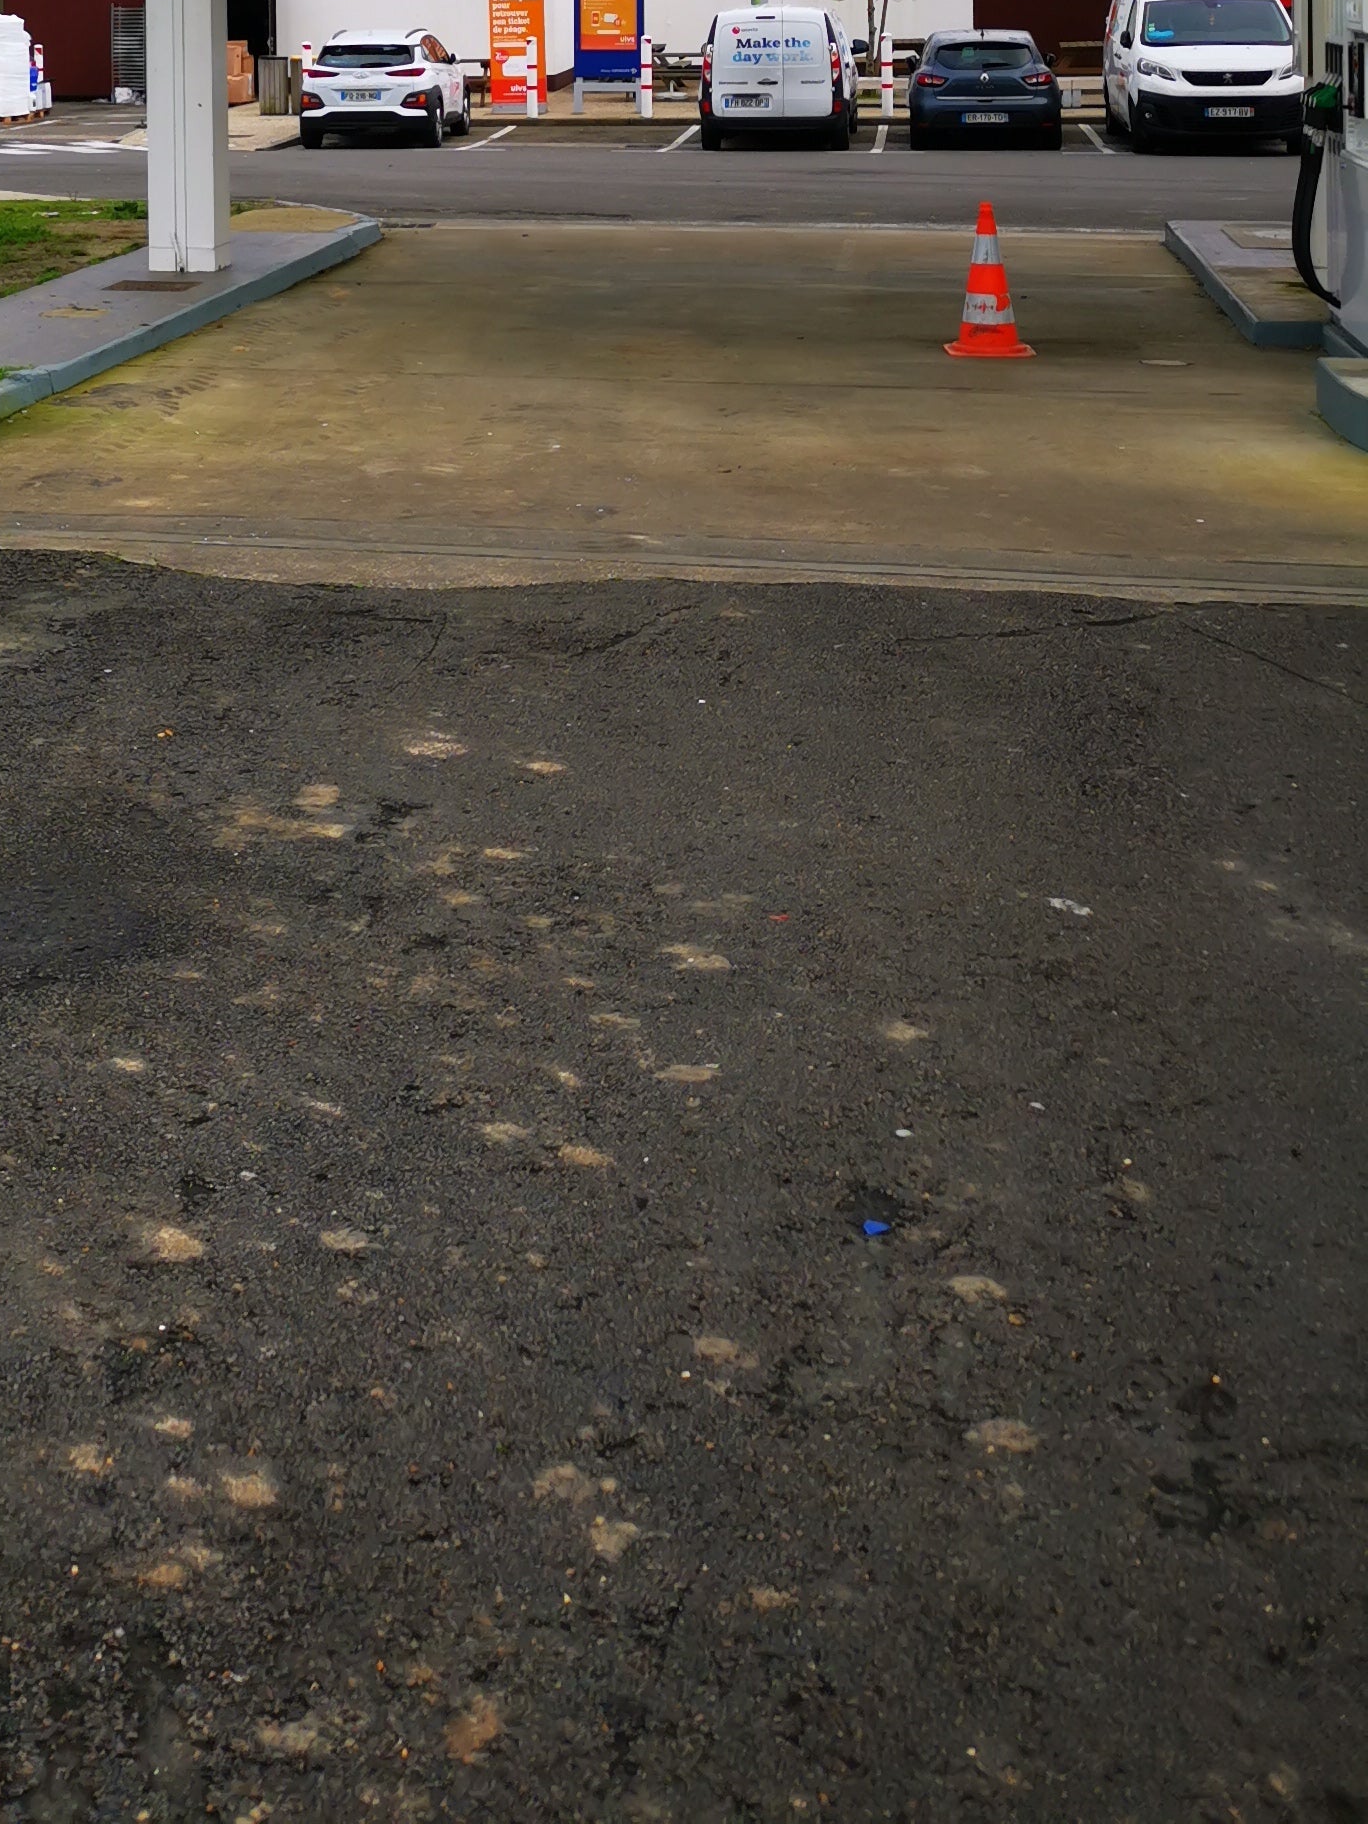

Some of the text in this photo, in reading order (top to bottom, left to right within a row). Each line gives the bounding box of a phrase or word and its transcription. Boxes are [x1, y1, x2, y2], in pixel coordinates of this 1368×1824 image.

[736, 37, 811, 49] Make the
[732, 50, 814, 65] day work.
